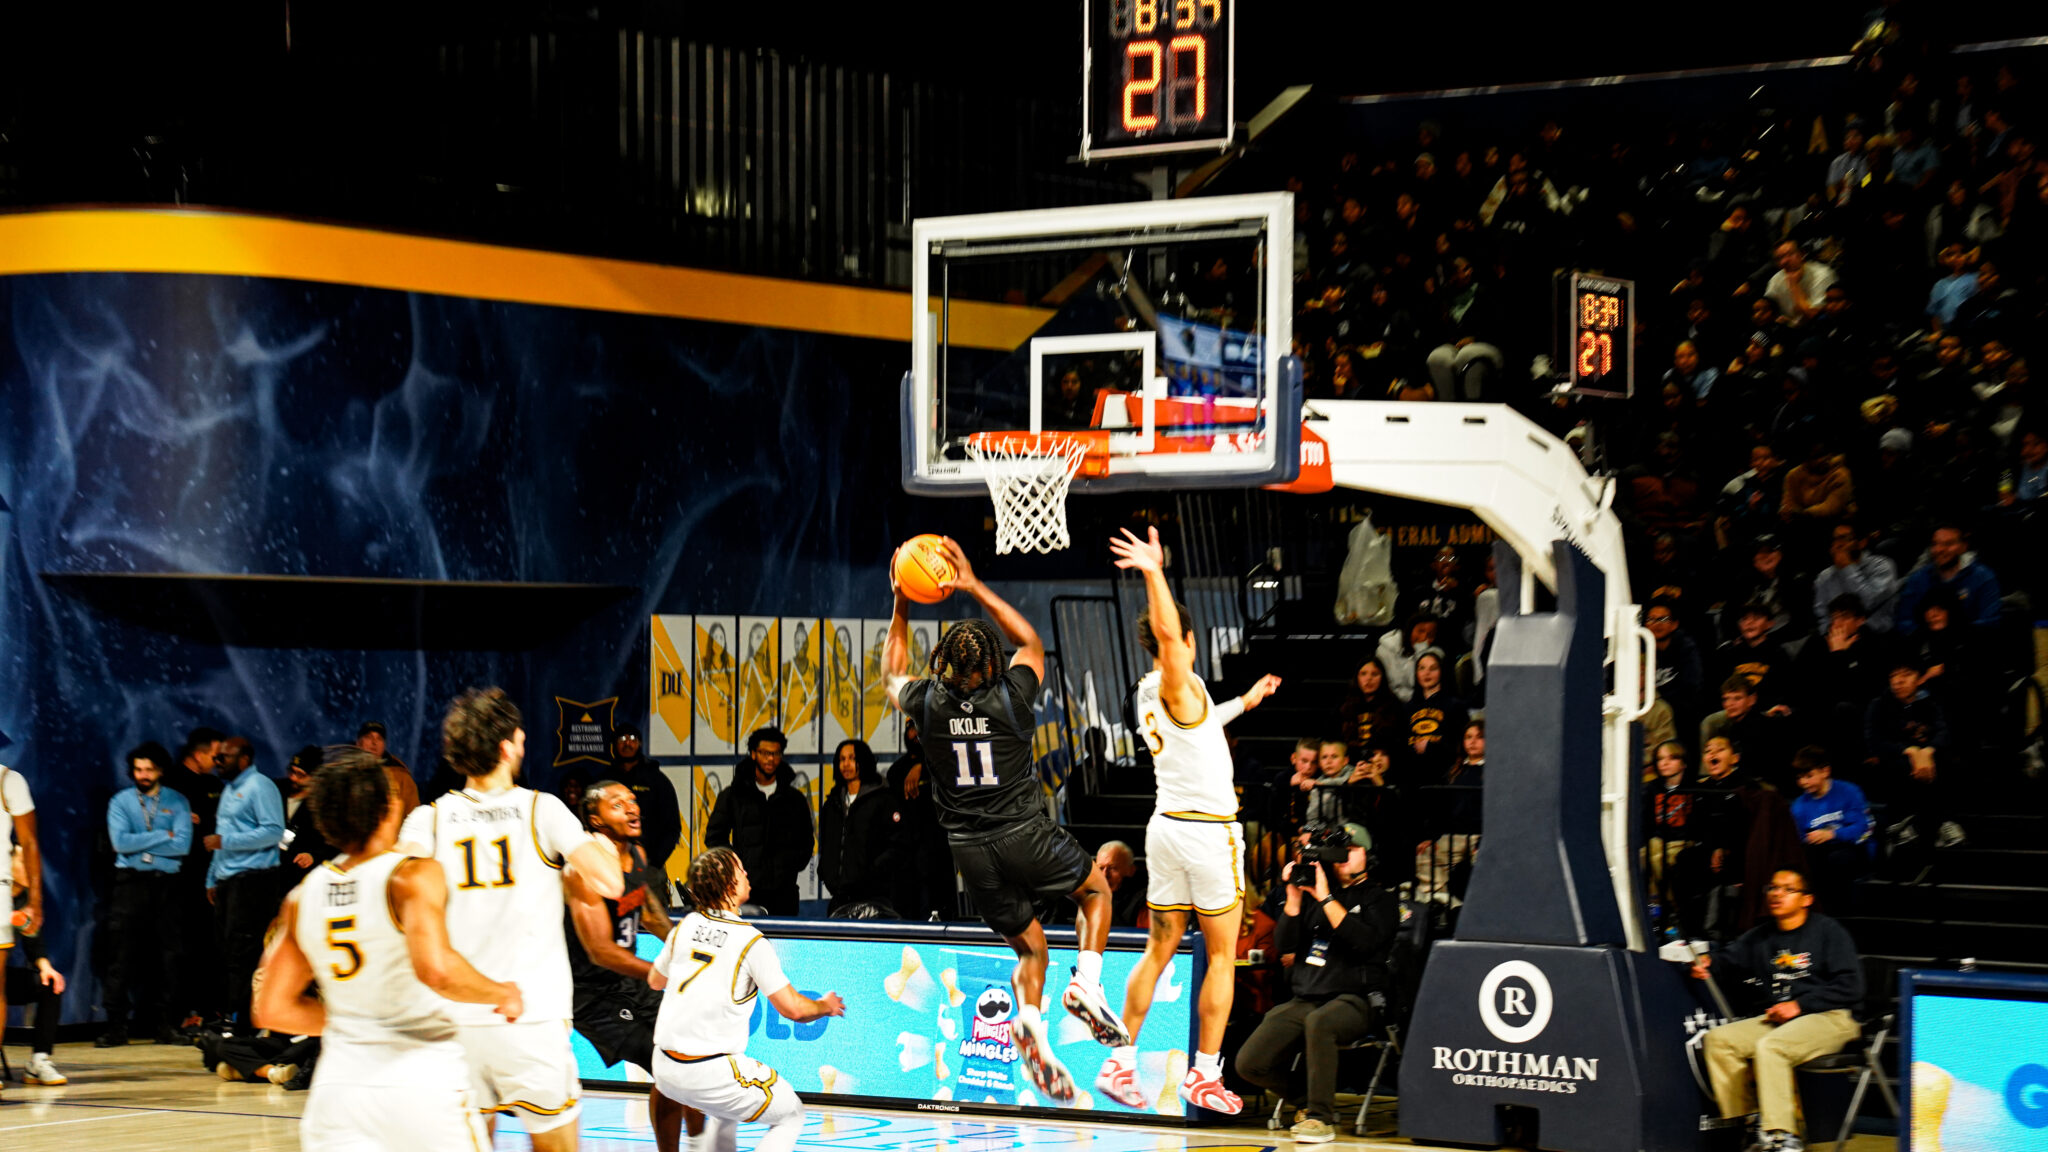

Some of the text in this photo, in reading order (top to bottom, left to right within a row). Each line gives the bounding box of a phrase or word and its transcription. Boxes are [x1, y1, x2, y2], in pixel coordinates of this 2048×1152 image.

[1123, 35, 1206, 132] 27
[1583, 293, 1619, 327] 8:39
[1579, 331, 1612, 377] 27
[1447, 523, 1497, 545] ADMI
[661, 671, 682, 696] DU
[840, 698, 849, 718] 8
[949, 717, 992, 736] OKOJIE
[1145, 711, 1164, 757] 3
[951, 741, 1000, 787] 11
[454, 835, 515, 890] 11
[327, 916, 364, 981] 5
[678, 948, 716, 994] 7
[1432, 1046, 1599, 1081] ROTHMAN
[1452, 1073, 1577, 1094] ORTHOPAEDICS
[917, 1103, 960, 1112] DAKTRONICS
